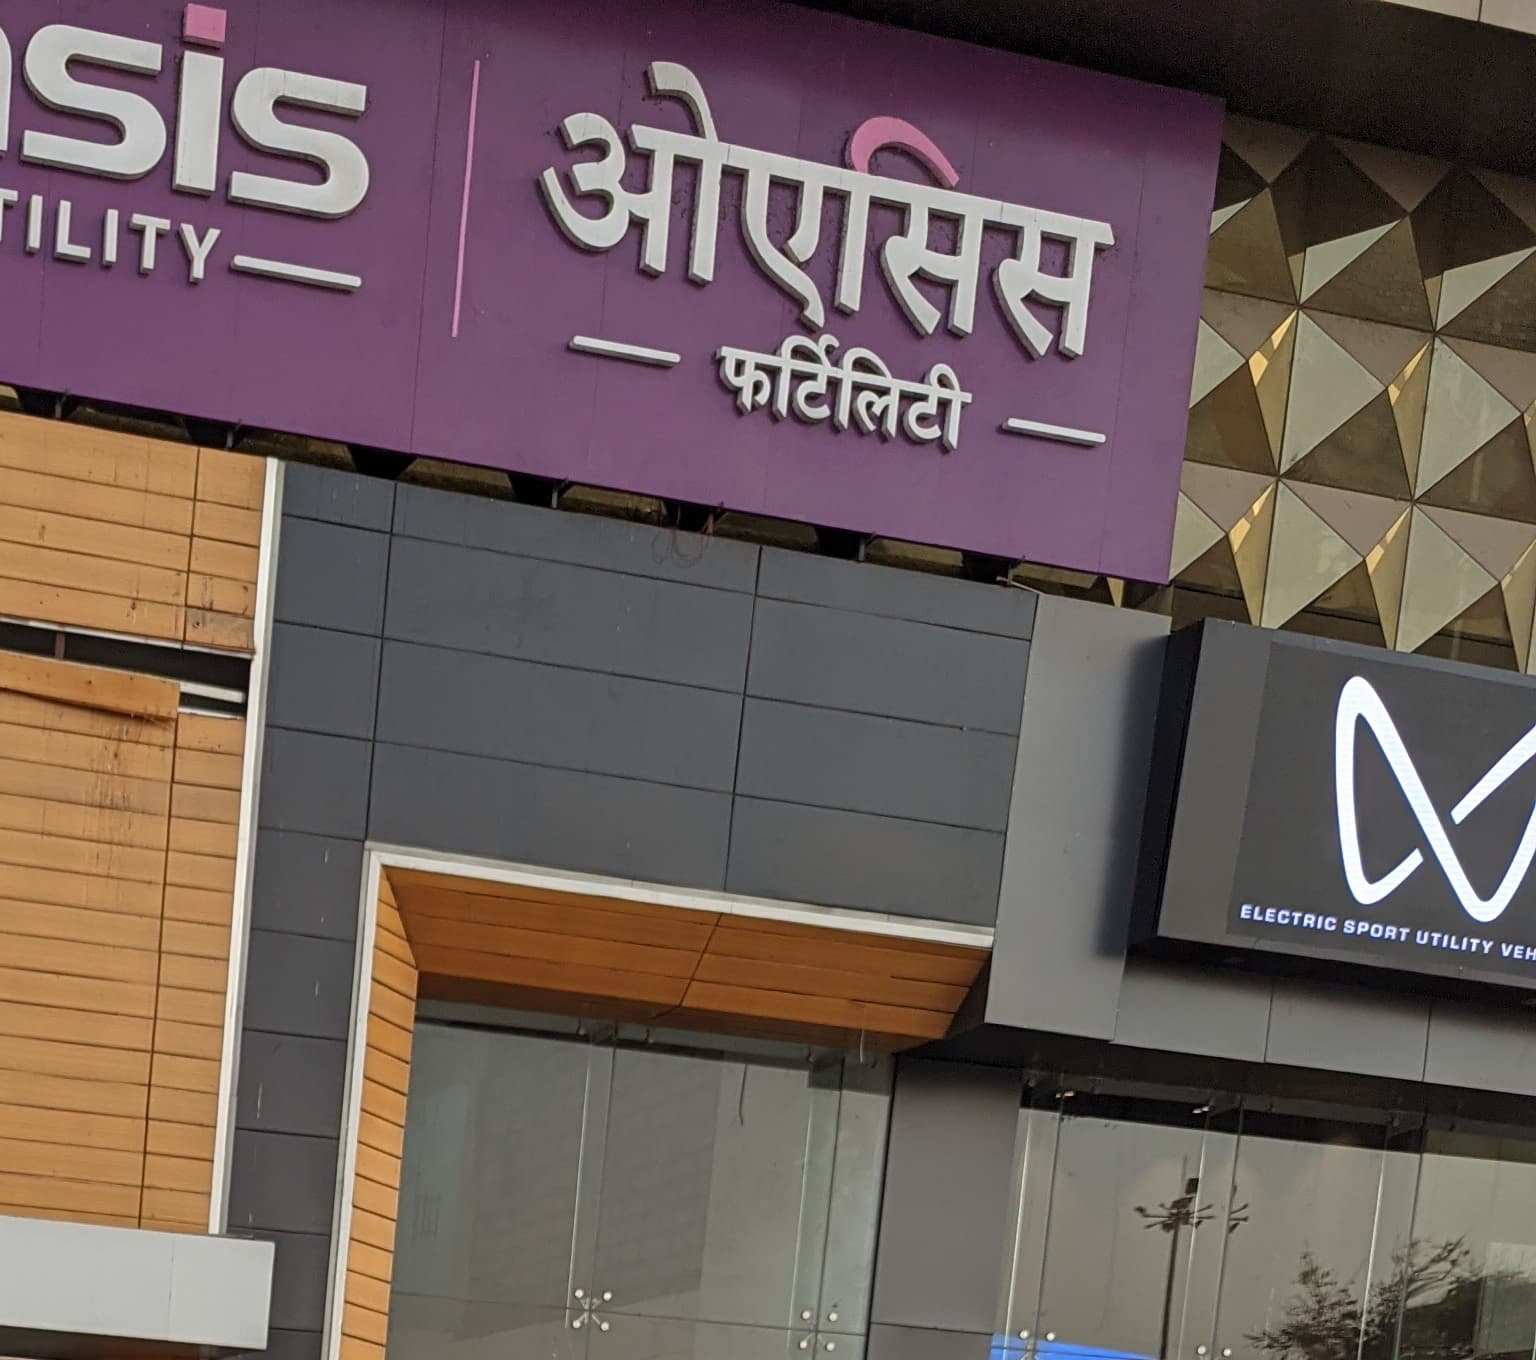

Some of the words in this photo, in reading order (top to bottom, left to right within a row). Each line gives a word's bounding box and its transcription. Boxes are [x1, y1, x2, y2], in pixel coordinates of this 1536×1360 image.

[539, 61, 1115, 359] ओएसिस
[716, 334, 972, 452] फर्टिलिटी
[1240, 904, 1337, 931] ELECTRIC
[1343, 920, 1410, 942] SPORT
[1415, 930, 1494, 954] UTILITY
[1501, 942, 1536, 961] VEH
